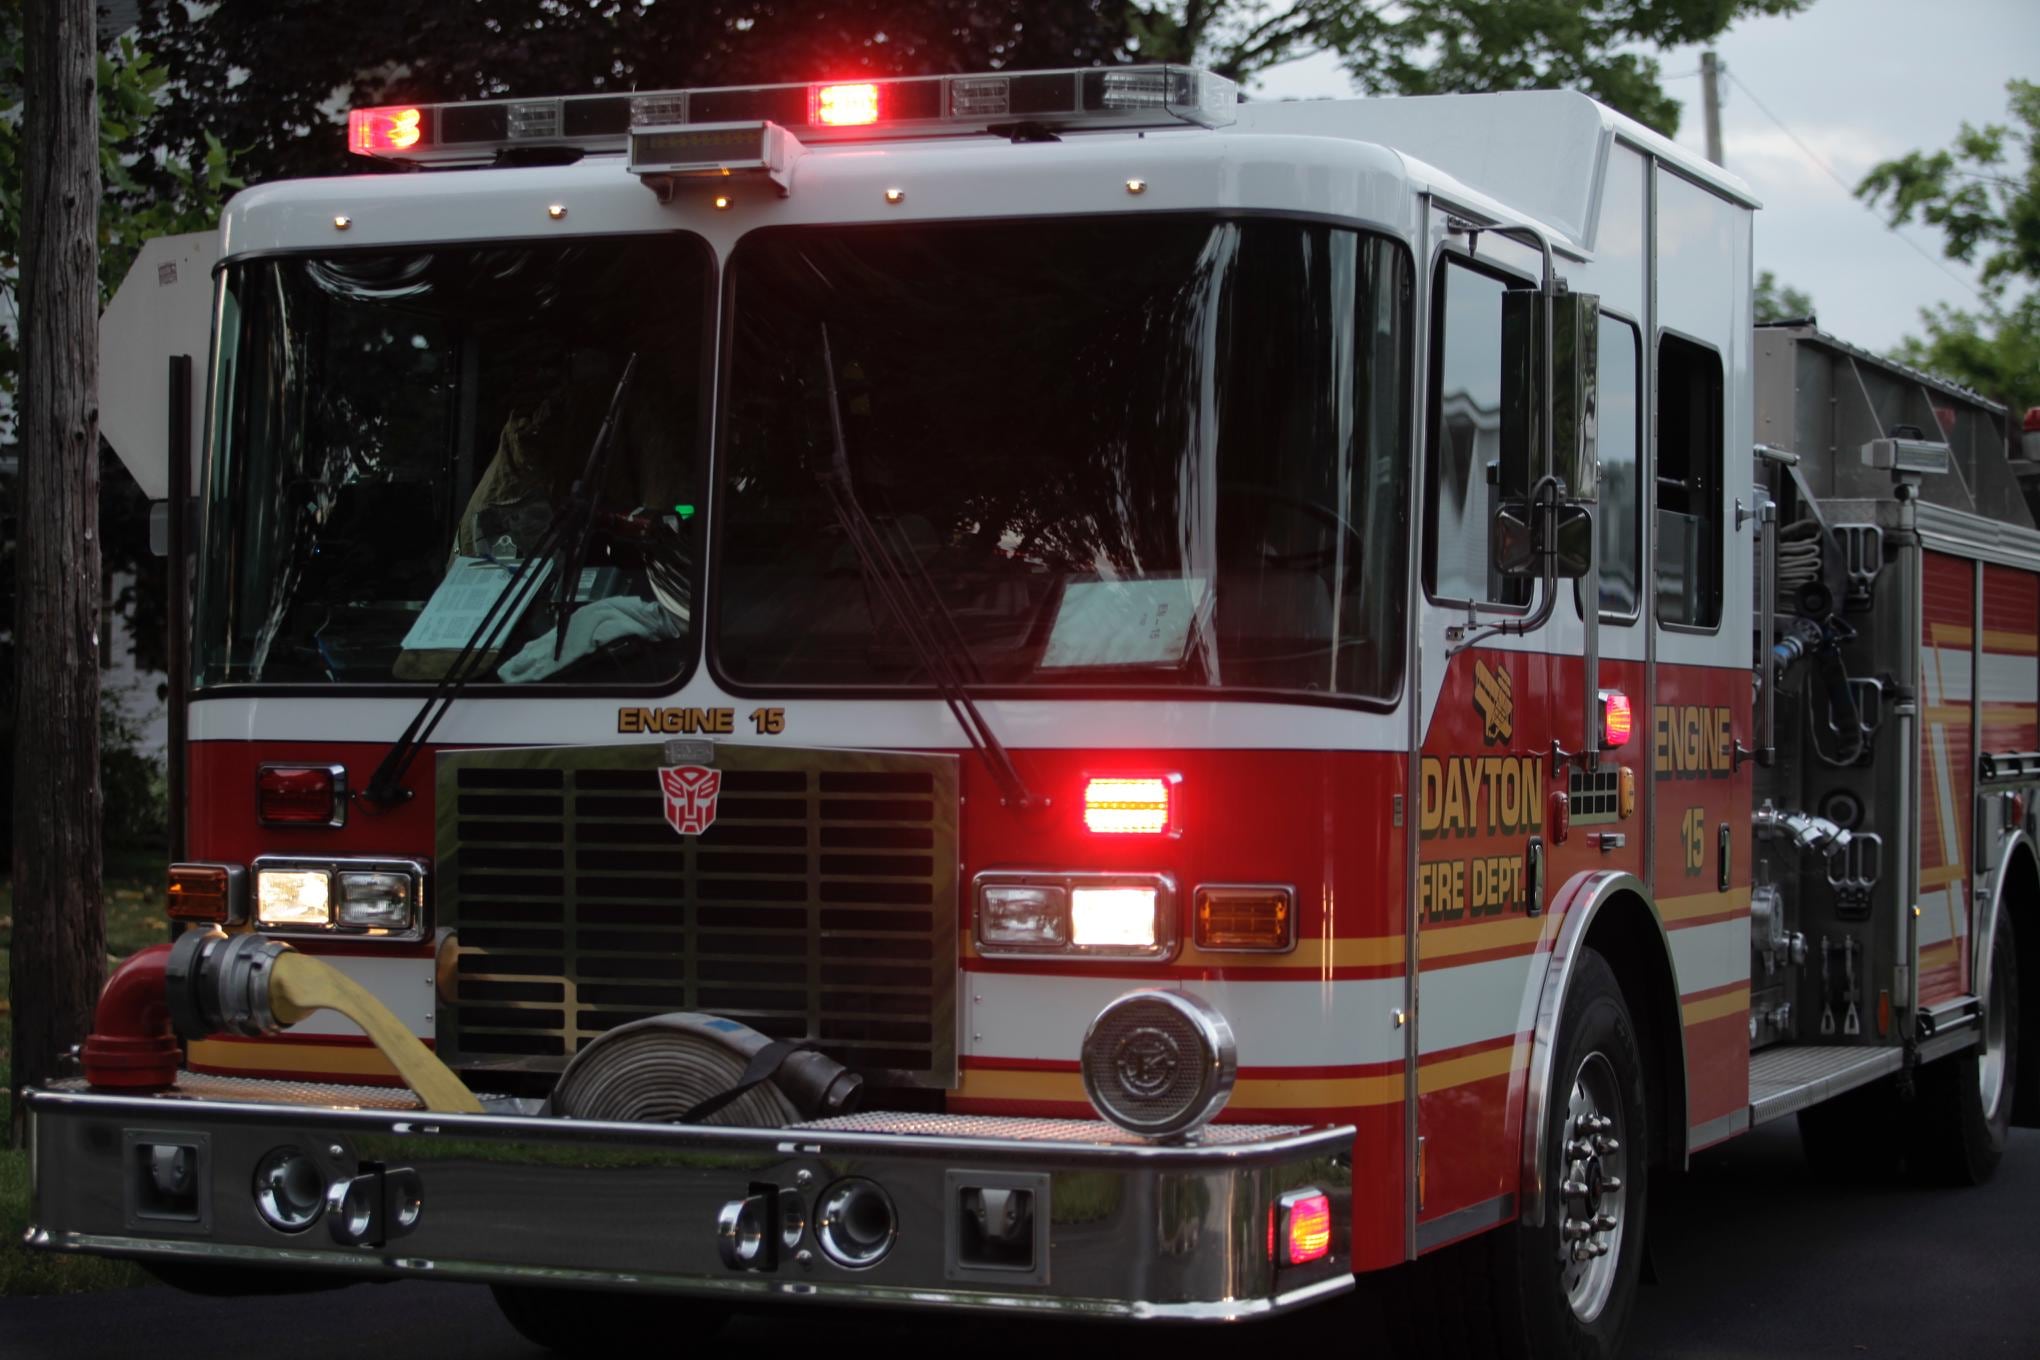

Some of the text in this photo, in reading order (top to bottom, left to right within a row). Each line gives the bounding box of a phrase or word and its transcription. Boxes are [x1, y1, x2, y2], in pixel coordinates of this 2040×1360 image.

[618, 707, 785, 734] ENGINE 15
[1654, 705, 1730, 780] ENGINE
[1420, 755, 1543, 838] DAYTON
[1681, 807, 1704, 876] 15
[1419, 855, 1526, 922] FIRE DEPT.
